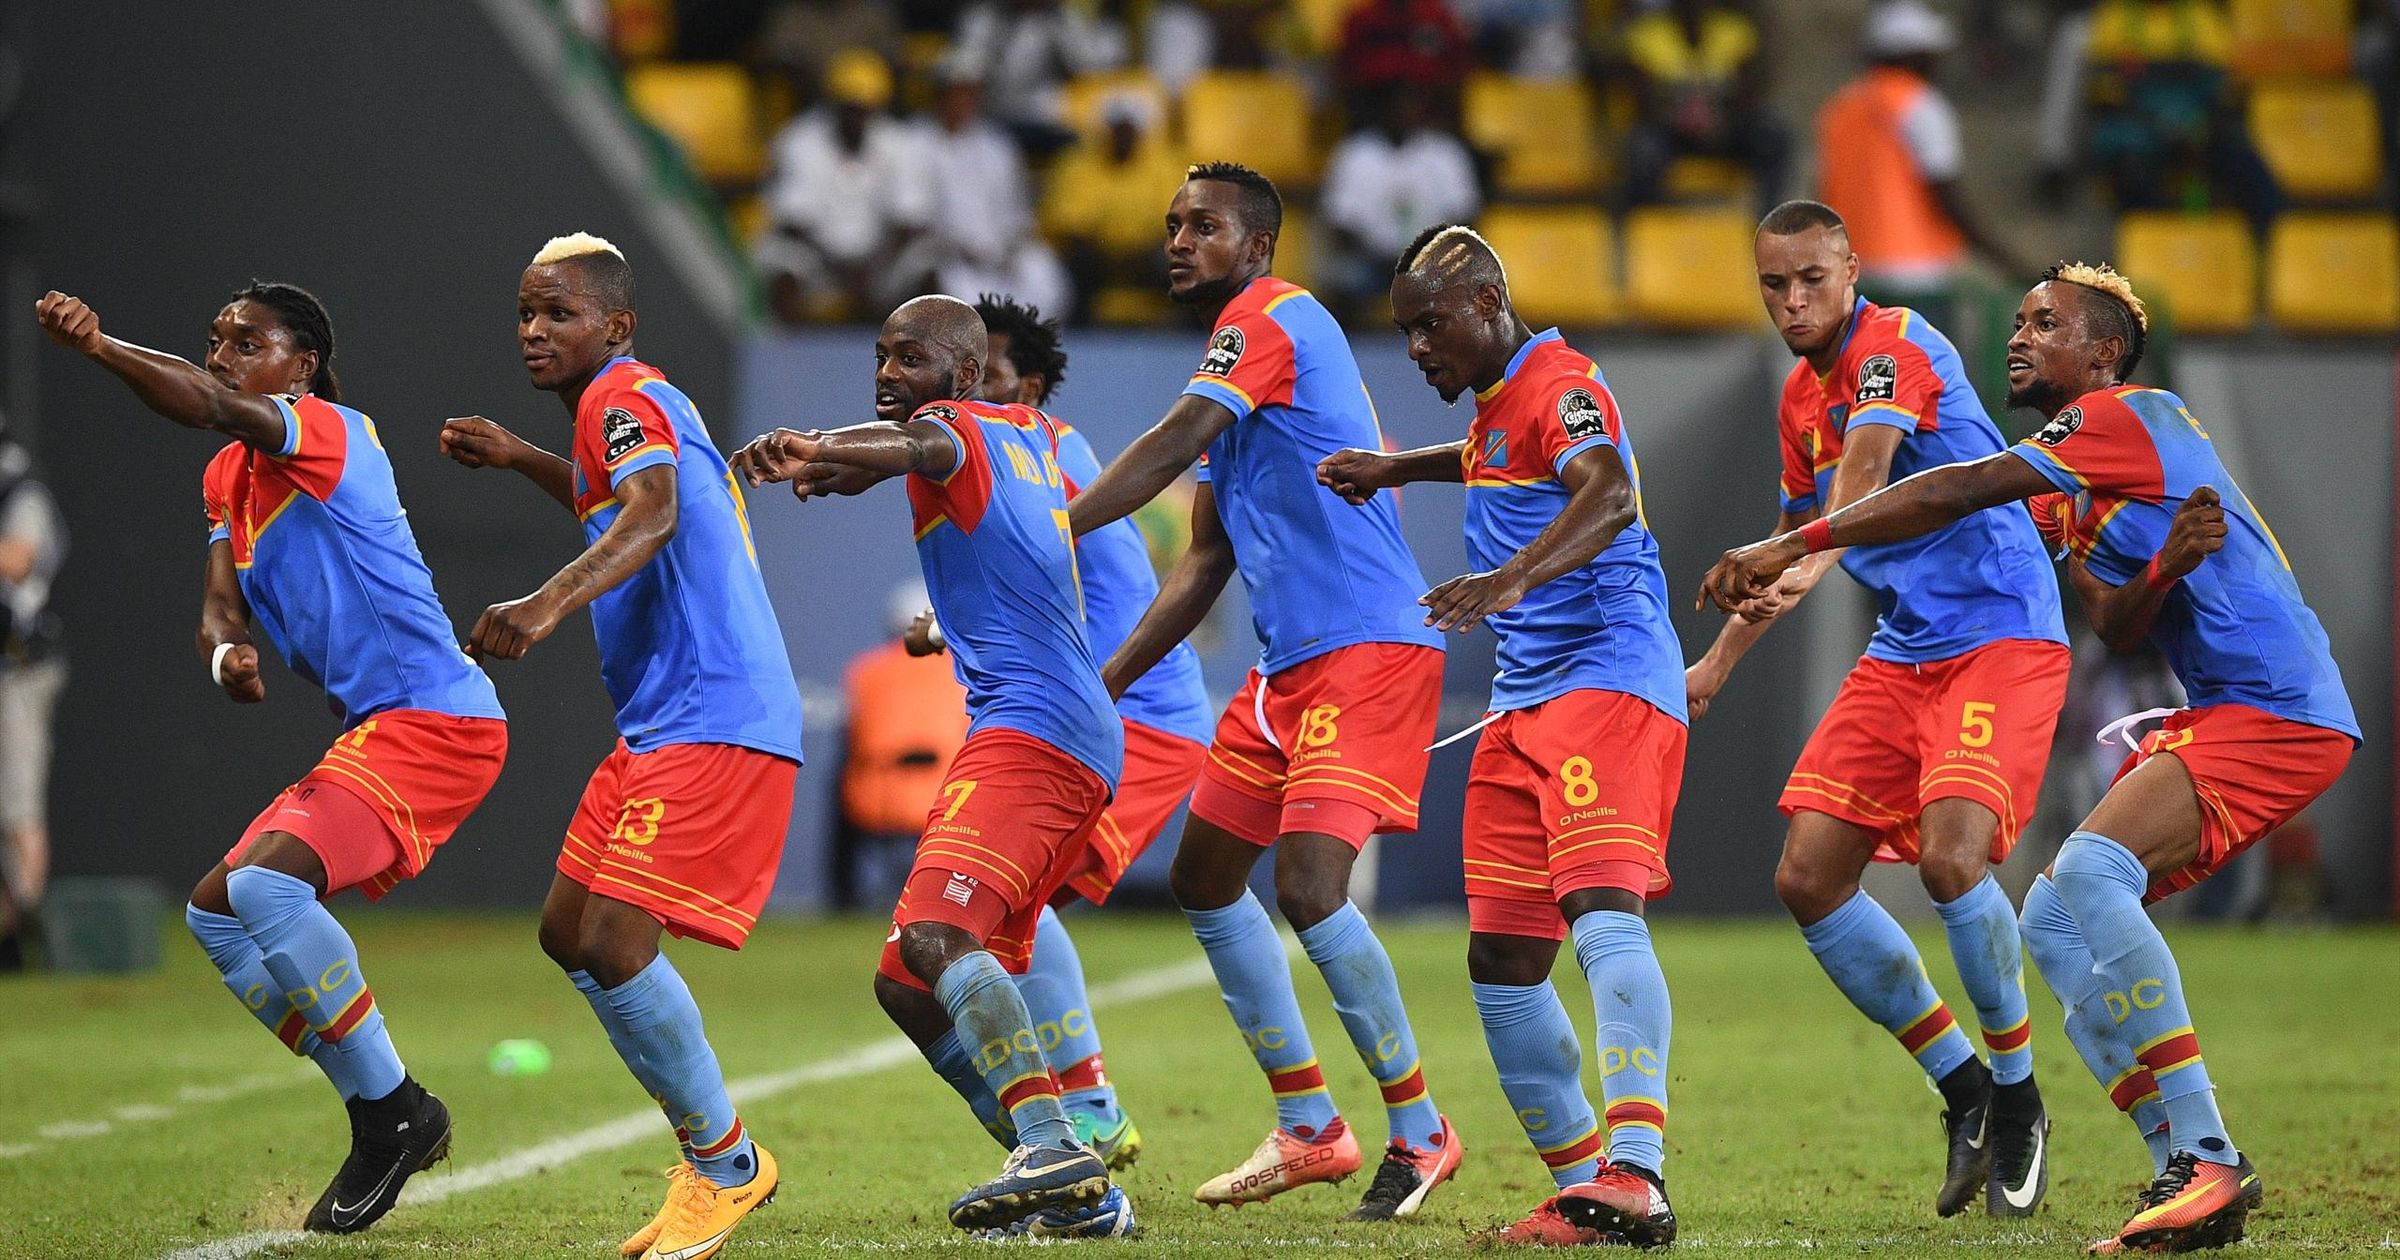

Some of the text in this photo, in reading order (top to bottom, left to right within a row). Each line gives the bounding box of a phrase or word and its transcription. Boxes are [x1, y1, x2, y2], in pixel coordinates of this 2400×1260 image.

[1293, 703, 1341, 754] 18
[1959, 701, 1996, 748] 5
[942, 780, 978, 822] 7
[1560, 755, 1599, 807] 8
[610, 797, 665, 846] 13
